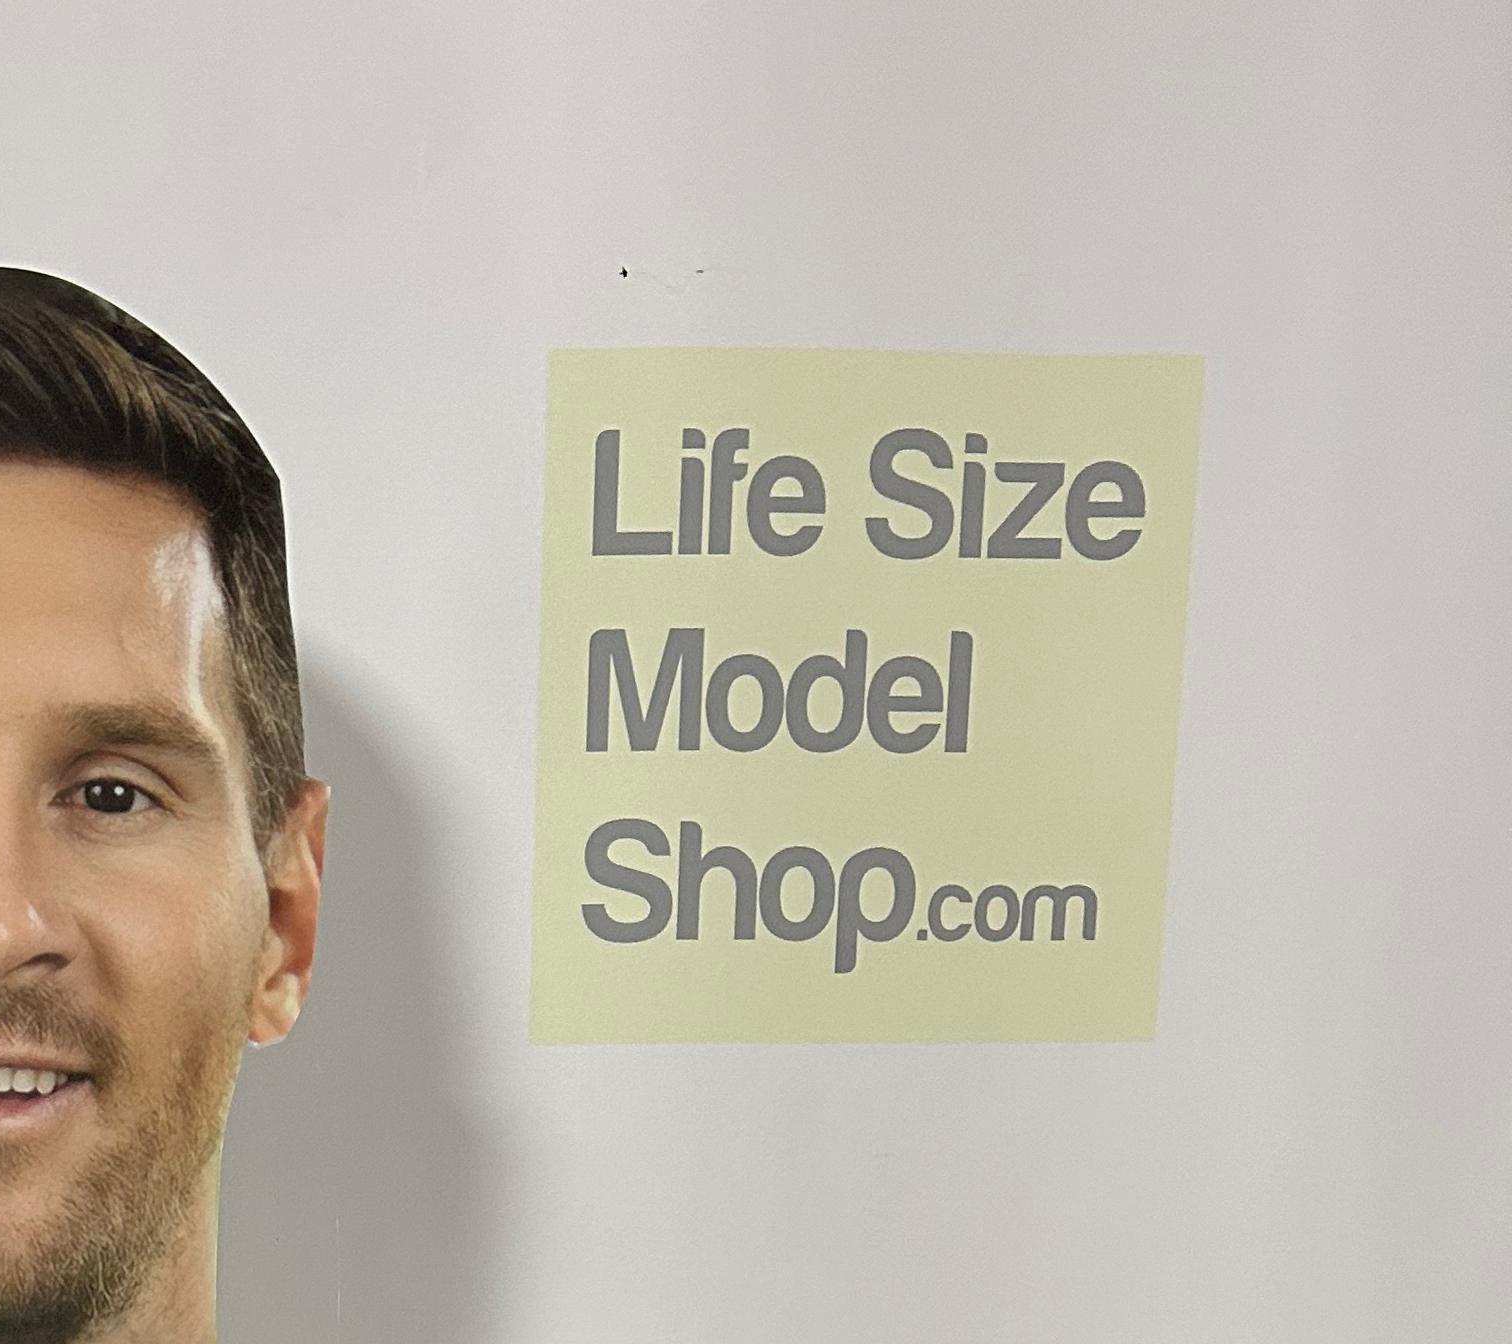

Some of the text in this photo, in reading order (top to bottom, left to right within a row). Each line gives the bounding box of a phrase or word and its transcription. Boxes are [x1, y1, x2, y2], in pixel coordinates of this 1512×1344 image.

[592, 427, 1147, 561] Life Size
[586, 627, 975, 754] Model
[581, 817, 1099, 974] Shop.com
